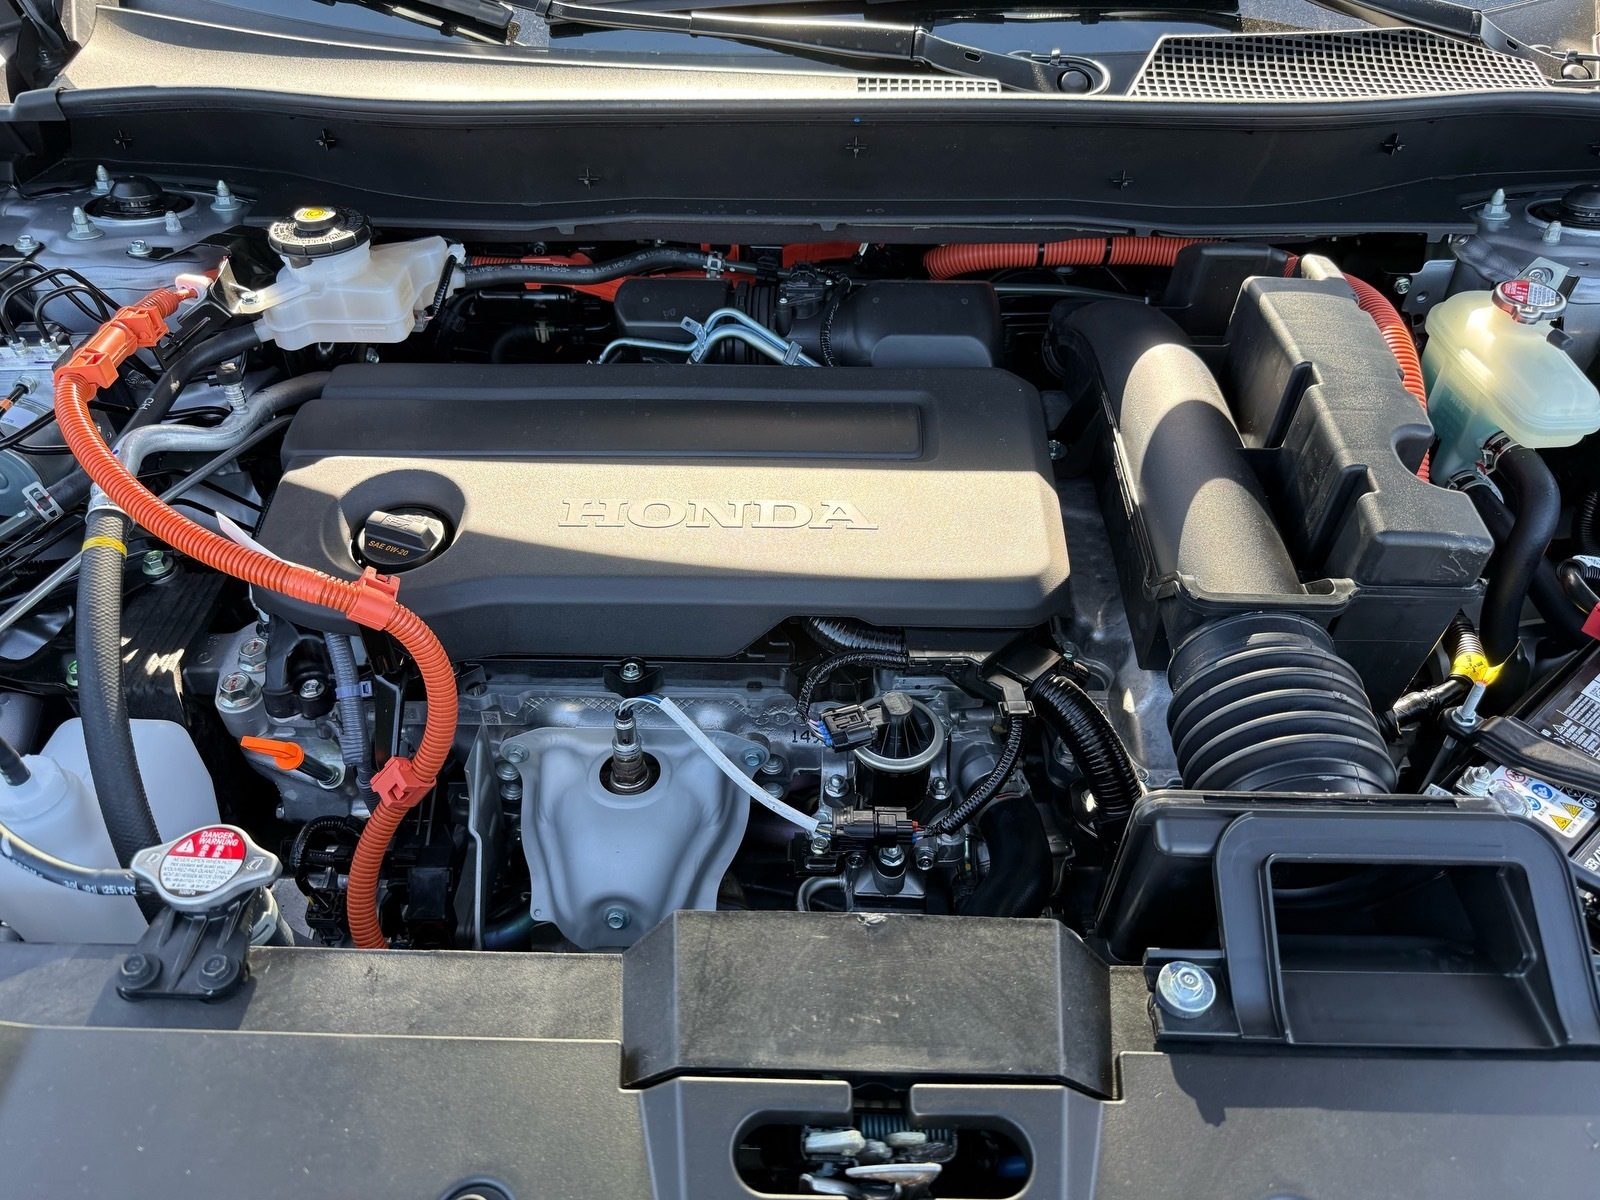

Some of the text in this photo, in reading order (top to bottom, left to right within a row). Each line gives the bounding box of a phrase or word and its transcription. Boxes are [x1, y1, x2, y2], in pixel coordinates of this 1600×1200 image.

[558, 499, 879, 530] HONDA
[368, 540, 409, 556] SAE 0W-20
[201, 830, 235, 840] DANGER
[198, 837, 239, 847] WARNUNG
[117, 886, 137, 895] TPC
